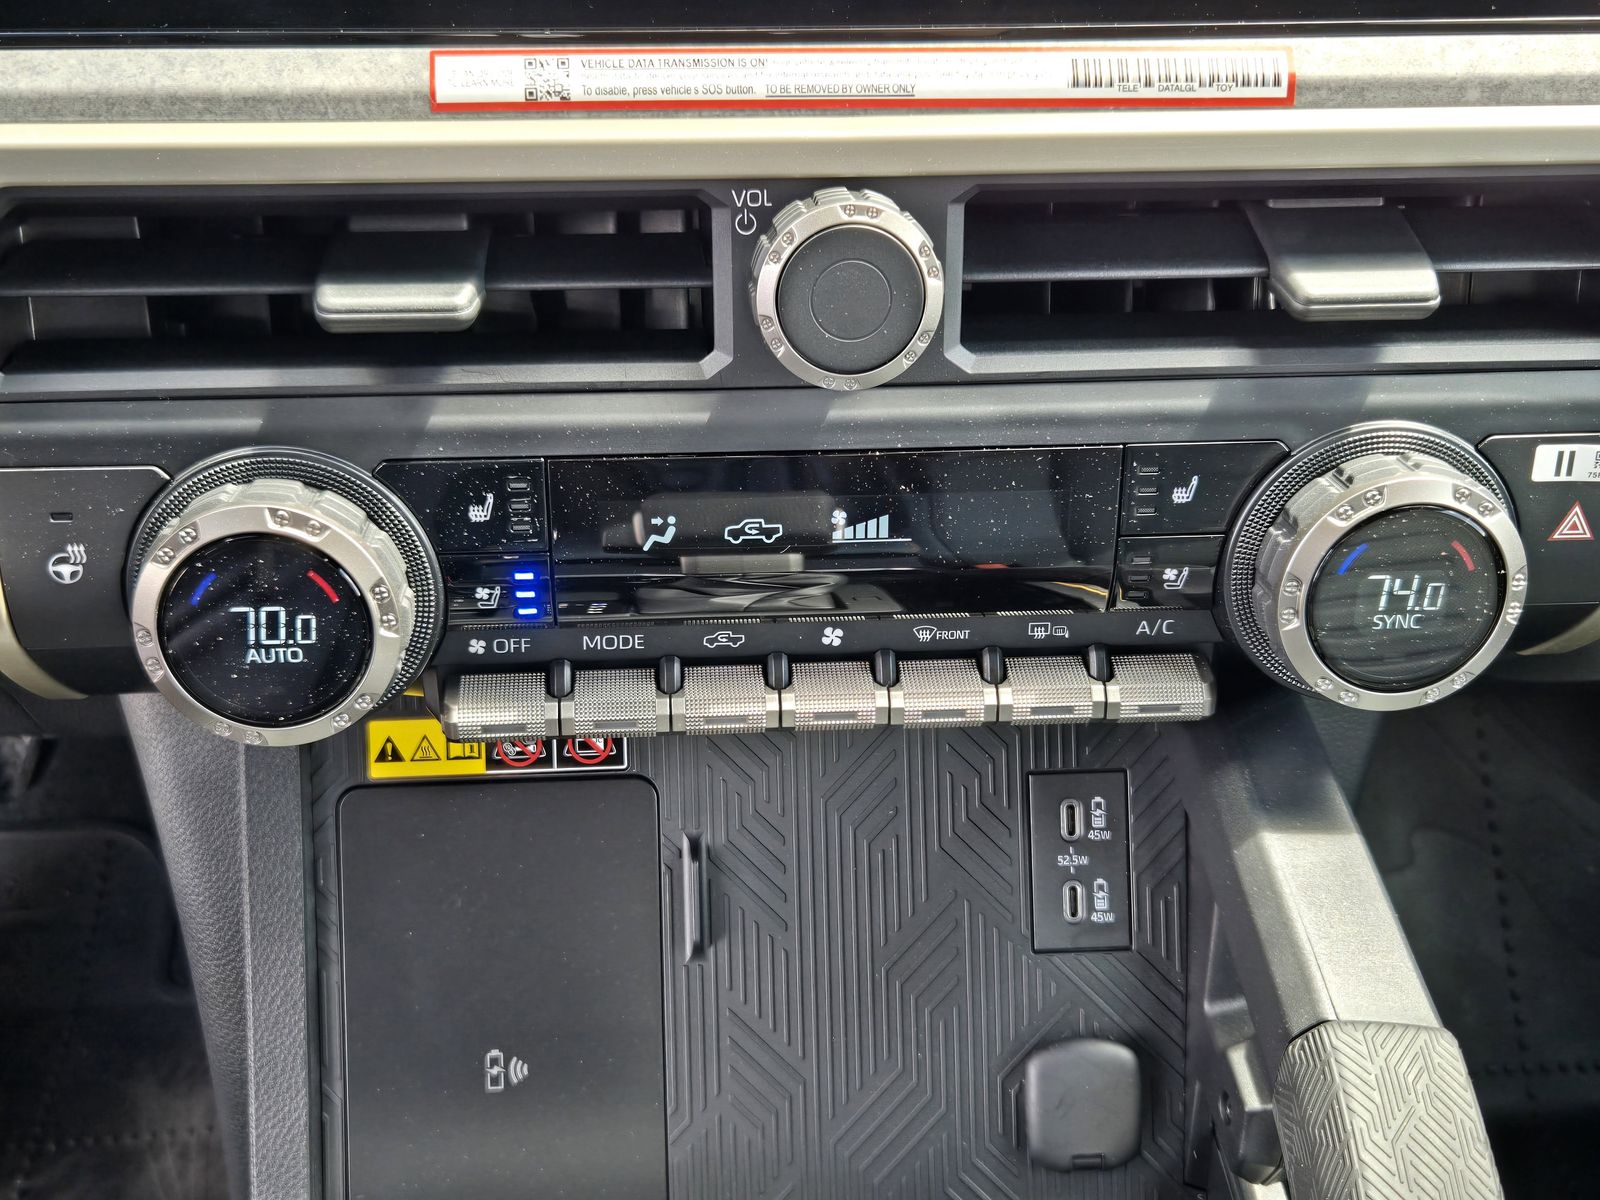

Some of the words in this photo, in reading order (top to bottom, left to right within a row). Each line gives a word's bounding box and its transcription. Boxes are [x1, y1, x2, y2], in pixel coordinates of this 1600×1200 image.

[580, 59, 624, 69] VEHICLE
[628, 59, 654, 69] DATA
[657, 58, 735, 69] TRANSMISSION
[738, 58, 747, 68] IS
[582, 84, 592, 96] To
[595, 84, 630, 97] disable,
[633, 86, 657, 98] press
[702, 84, 723, 95] SOS
[726, 84, 756, 95] button.
[766, 84, 777, 94] TO
[780, 84, 791, 94] BE
[794, 84, 840, 94] REMOVED
[842, 84, 853, 94] BY
[856, 83, 890, 94] OWNER
[892, 83, 916, 93] ONLY
[1117, 84, 1139, 93] TELE
[1157, 84, 1197, 93] DATALGL
[1215, 84, 1234, 92] TOY
[731, 189, 772, 207] VOL
[1368, 574, 1446, 611] 74.0
[228, 606, 317, 645] 70.0
[1135, 620, 1175, 635] A/C
[1372, 613, 1425, 630] SYNC
[582, 634, 645, 650] MODE
[936, 630, 970, 640] FRONT
[493, 638, 531, 654] OFF
[244, 647, 304, 663] AUTO
[1087, 830, 1111, 840] 45W
[1057, 855, 1089, 866] 52.5W
[1090, 912, 1114, 922] 45W
